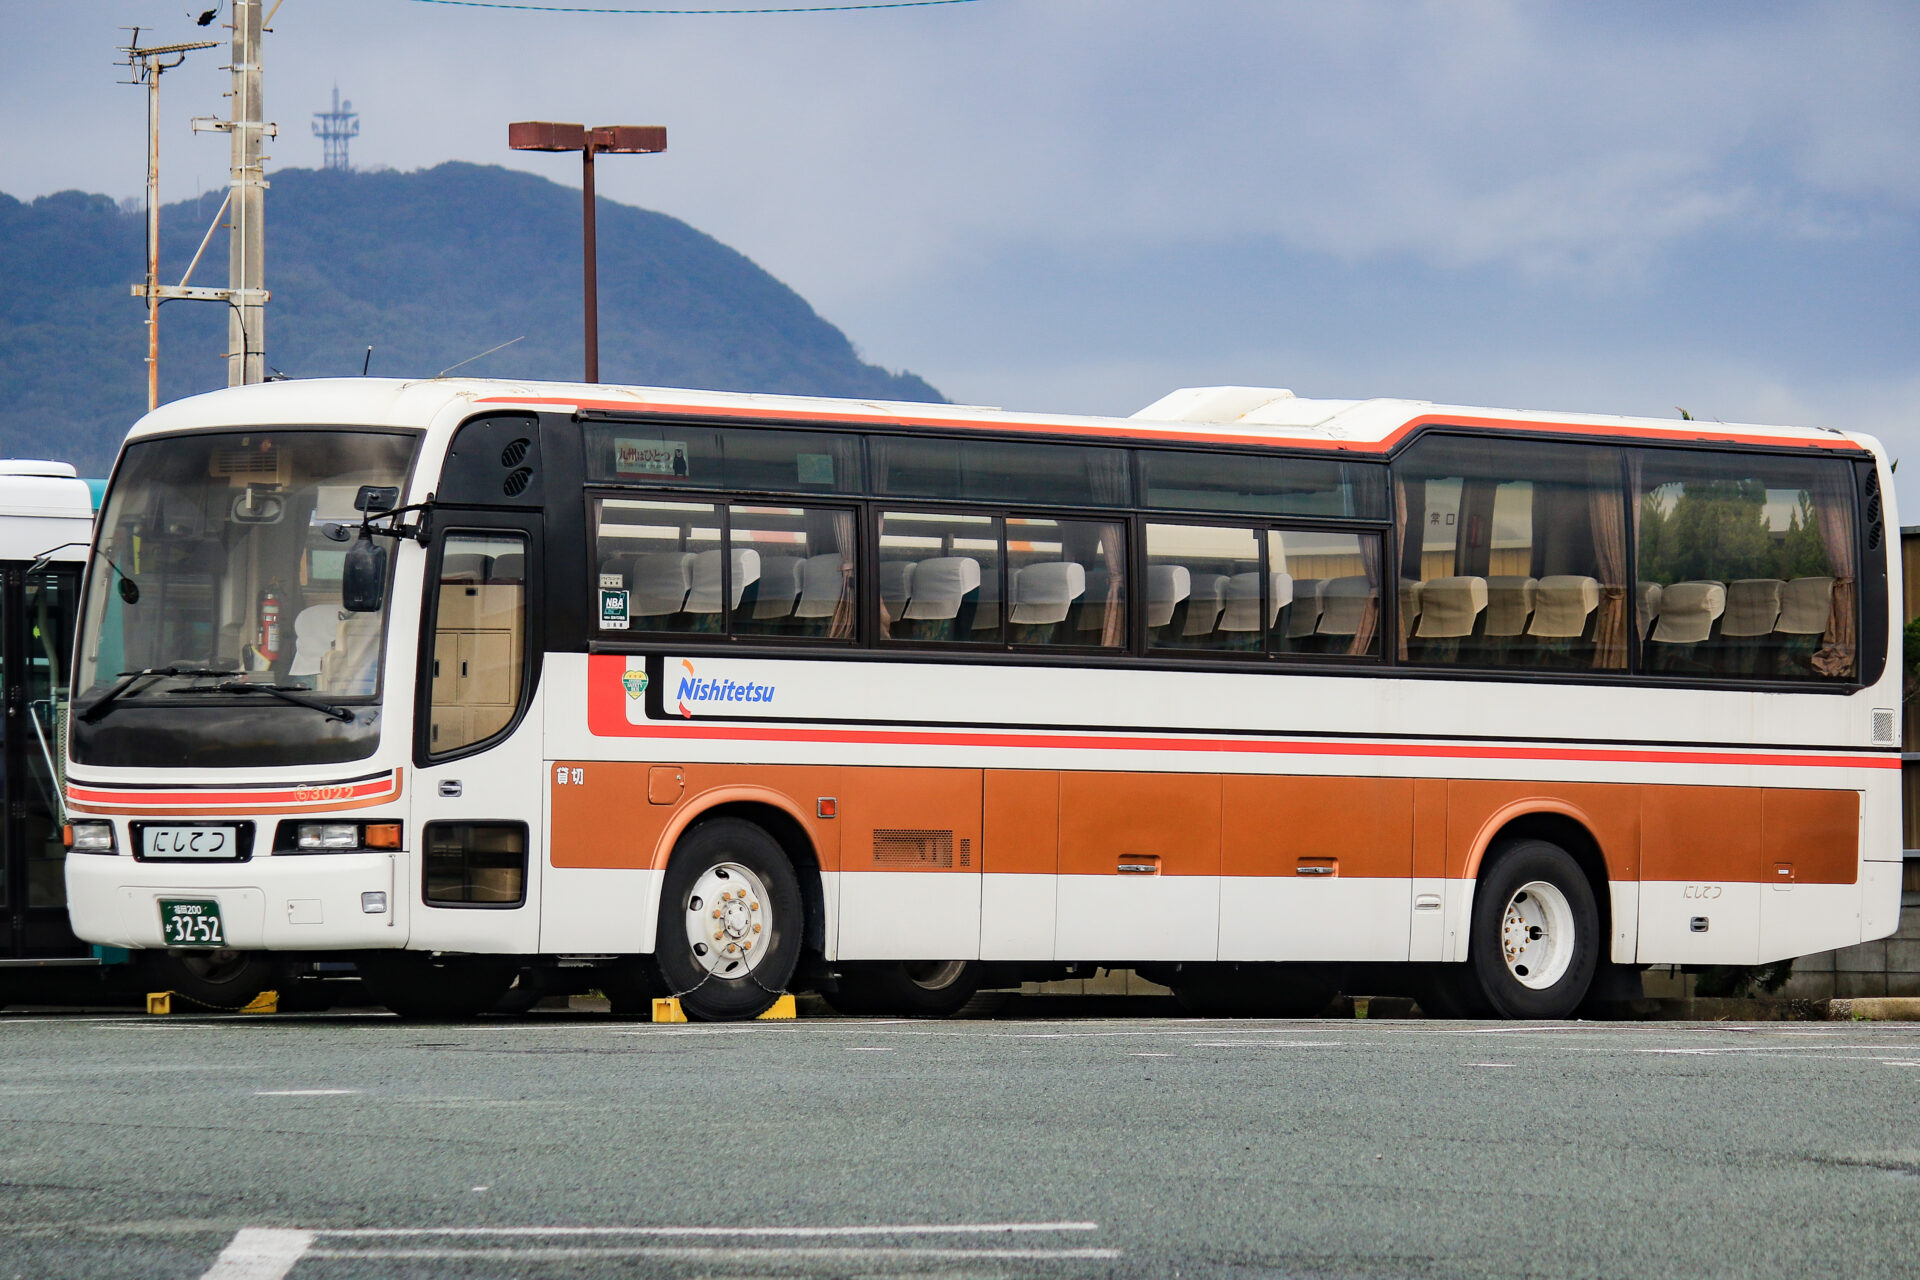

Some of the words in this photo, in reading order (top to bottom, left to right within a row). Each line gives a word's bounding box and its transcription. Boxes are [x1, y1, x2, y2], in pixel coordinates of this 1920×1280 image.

[605, 597, 624, 609] NBA
[676, 676, 776, 703] Nishitetsu
[556, 767, 585, 786] 貸切
[153, 831, 225, 853] にしてつ
[1682, 885, 1723, 900] にしてつ
[171, 915, 222, 942] 32-52
